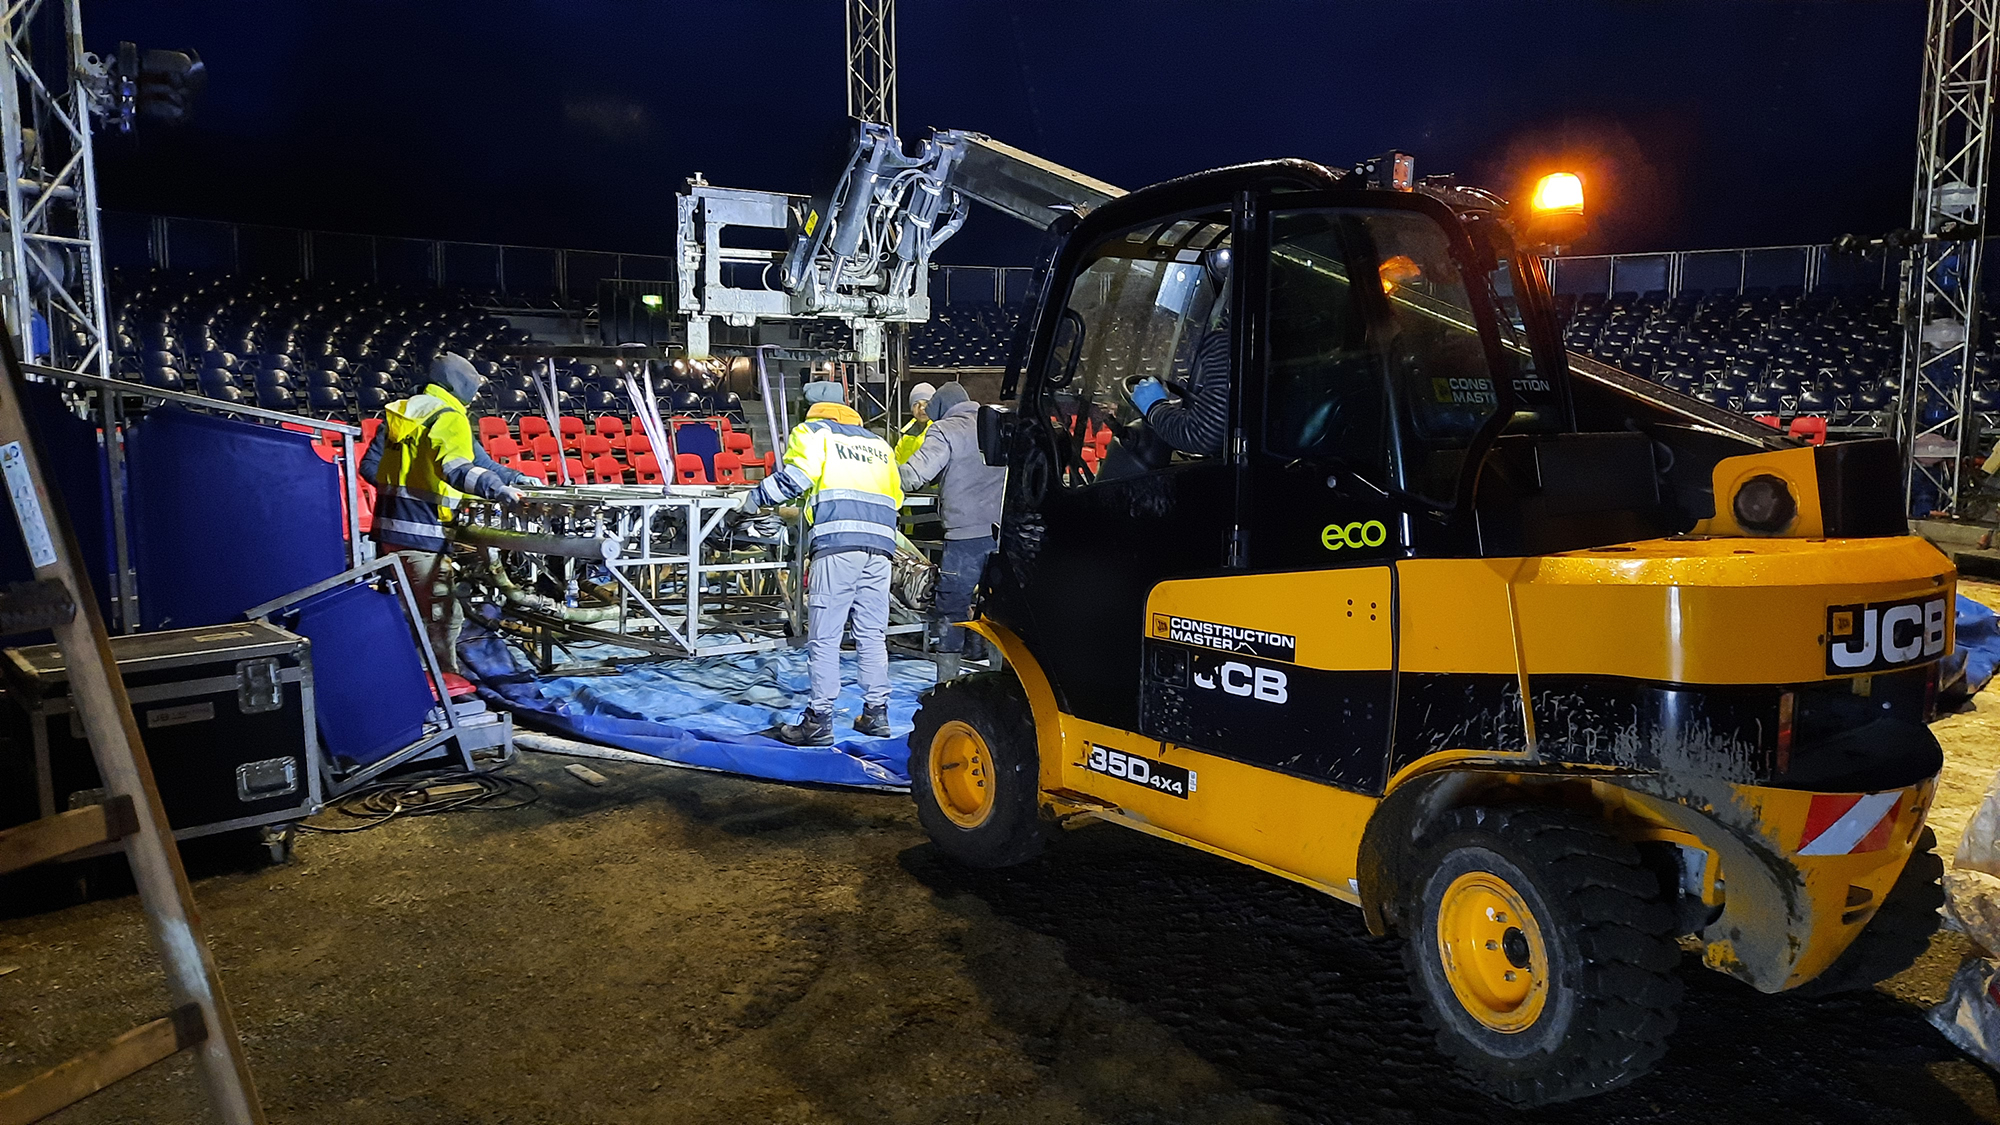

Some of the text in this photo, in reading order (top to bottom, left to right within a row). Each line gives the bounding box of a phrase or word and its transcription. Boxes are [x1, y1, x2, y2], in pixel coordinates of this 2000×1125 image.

[835, 443, 873, 465] KNIE
[851, 444, 888, 465] CHARLES
[1321, 519, 1387, 551] eco
[1170, 629, 1233, 651] MASTER
[1171, 617, 1294, 648] CONSTRUCTION
[1831, 598, 1946, 668] JCB
[1088, 746, 1150, 784] 35D
